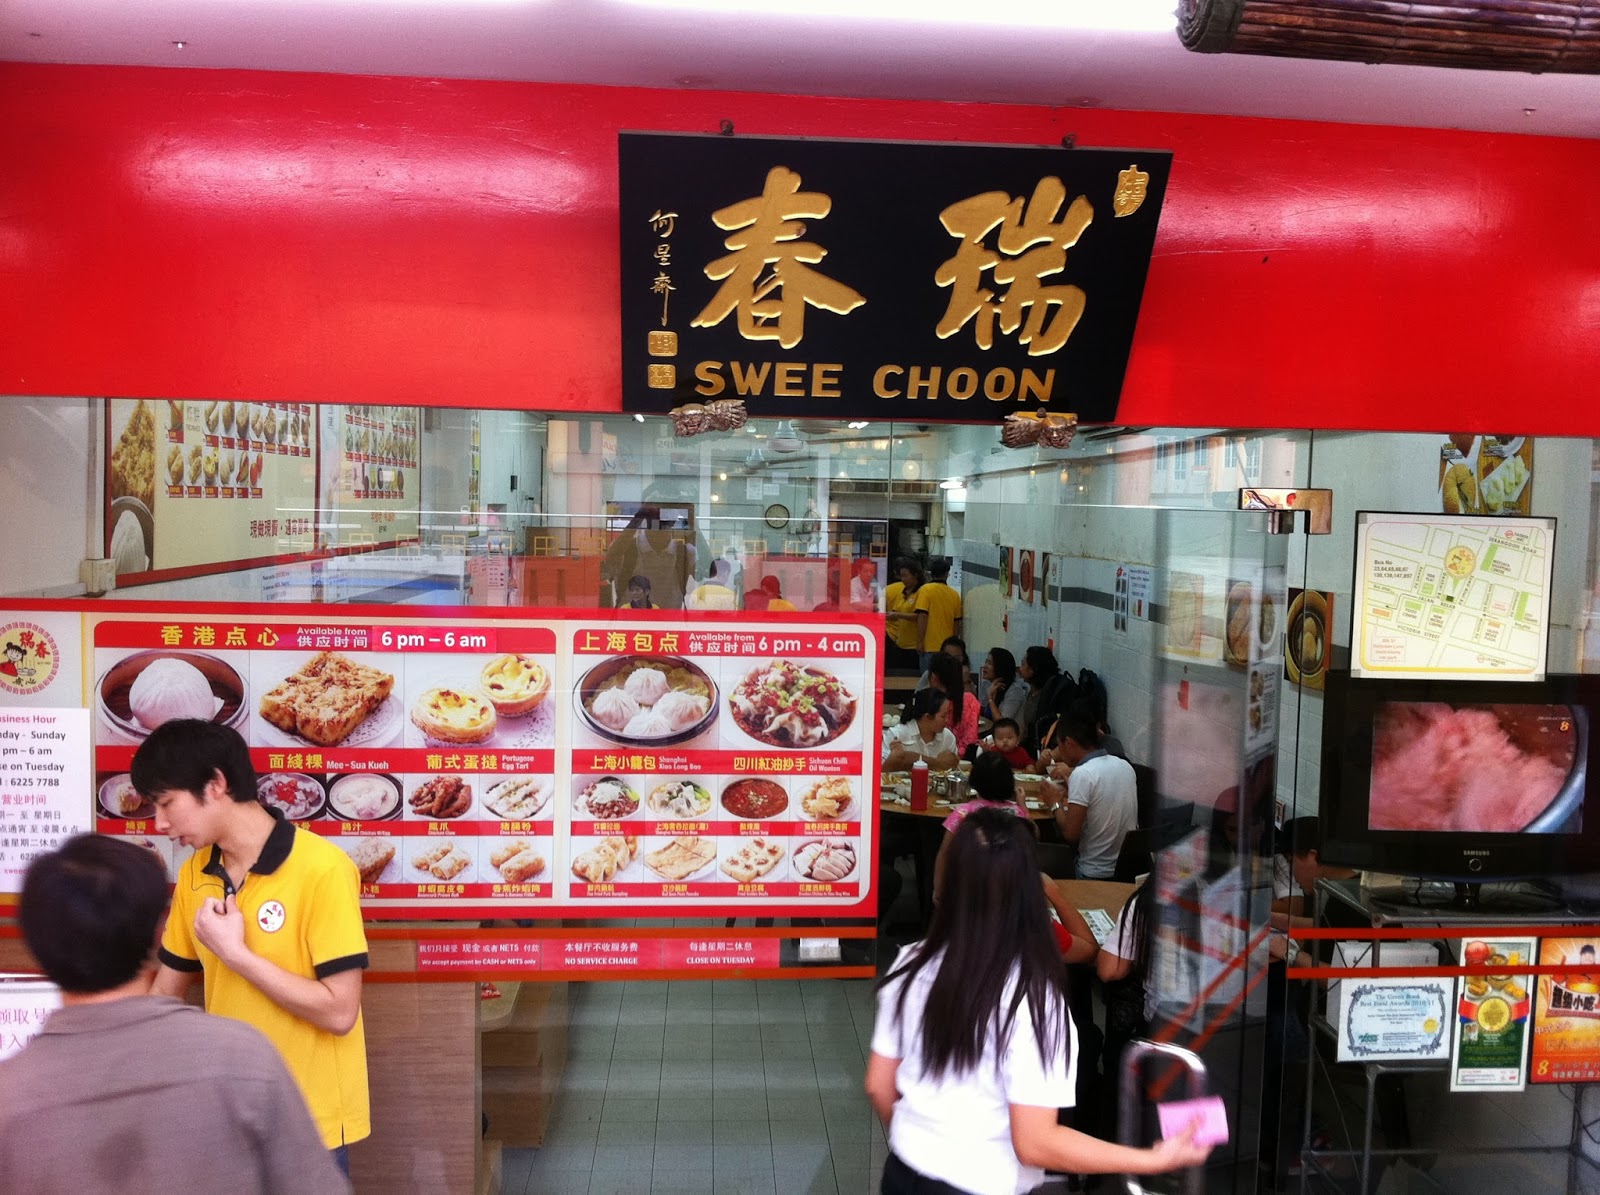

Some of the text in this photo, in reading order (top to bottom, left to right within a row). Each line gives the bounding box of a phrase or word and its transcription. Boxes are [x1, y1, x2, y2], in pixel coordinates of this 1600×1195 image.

[694, 361, 844, 398] SWEE
[872, 365, 1056, 403] CHOON
[161, 625, 279, 646] 香港点心
[297, 626, 367, 636] Available from
[381, 632, 392, 645] 6
[397, 634, 425, 649] pm
[444, 633, 455, 647] 6
[459, 636, 486, 648] am
[580, 632, 679, 652] 上海包点
[689, 633, 732, 641] Available
[297, 636, 368, 649] 供应时间
[689, 641, 755, 653] 供应时间
[759, 637, 768, 651] 6
[774, 639, 800, 655] pm
[818, 638, 828, 652] 4
[833, 640, 860, 653] am
[33, 715, 56, 724] Hour
[1560, 721, 1570, 731] 8
[31, 731, 66, 741] Sunday
[3, 747, 18, 757] pm
[29, 747, 35, 755] 6
[368, 761, 389, 769] Kueh
[659, 756, 687, 764] Shanghai
[25, 762, 65, 773] Tuesday
[10, 778, 34, 787] 6225
[37, 778, 60, 787] 7788
[2, 794, 47, 805] 营业时间
[34, 810, 61, 820] 星期日
[462, 943, 480, 952] 现金
[499, 944, 519, 952] NETS
[523, 944, 539, 952] 付款
[565, 942, 638, 952] 本餐厅不收服务费
[689, 942, 752, 951] 每逢星期二休息
[1537, 1060, 1549, 1075] 8
